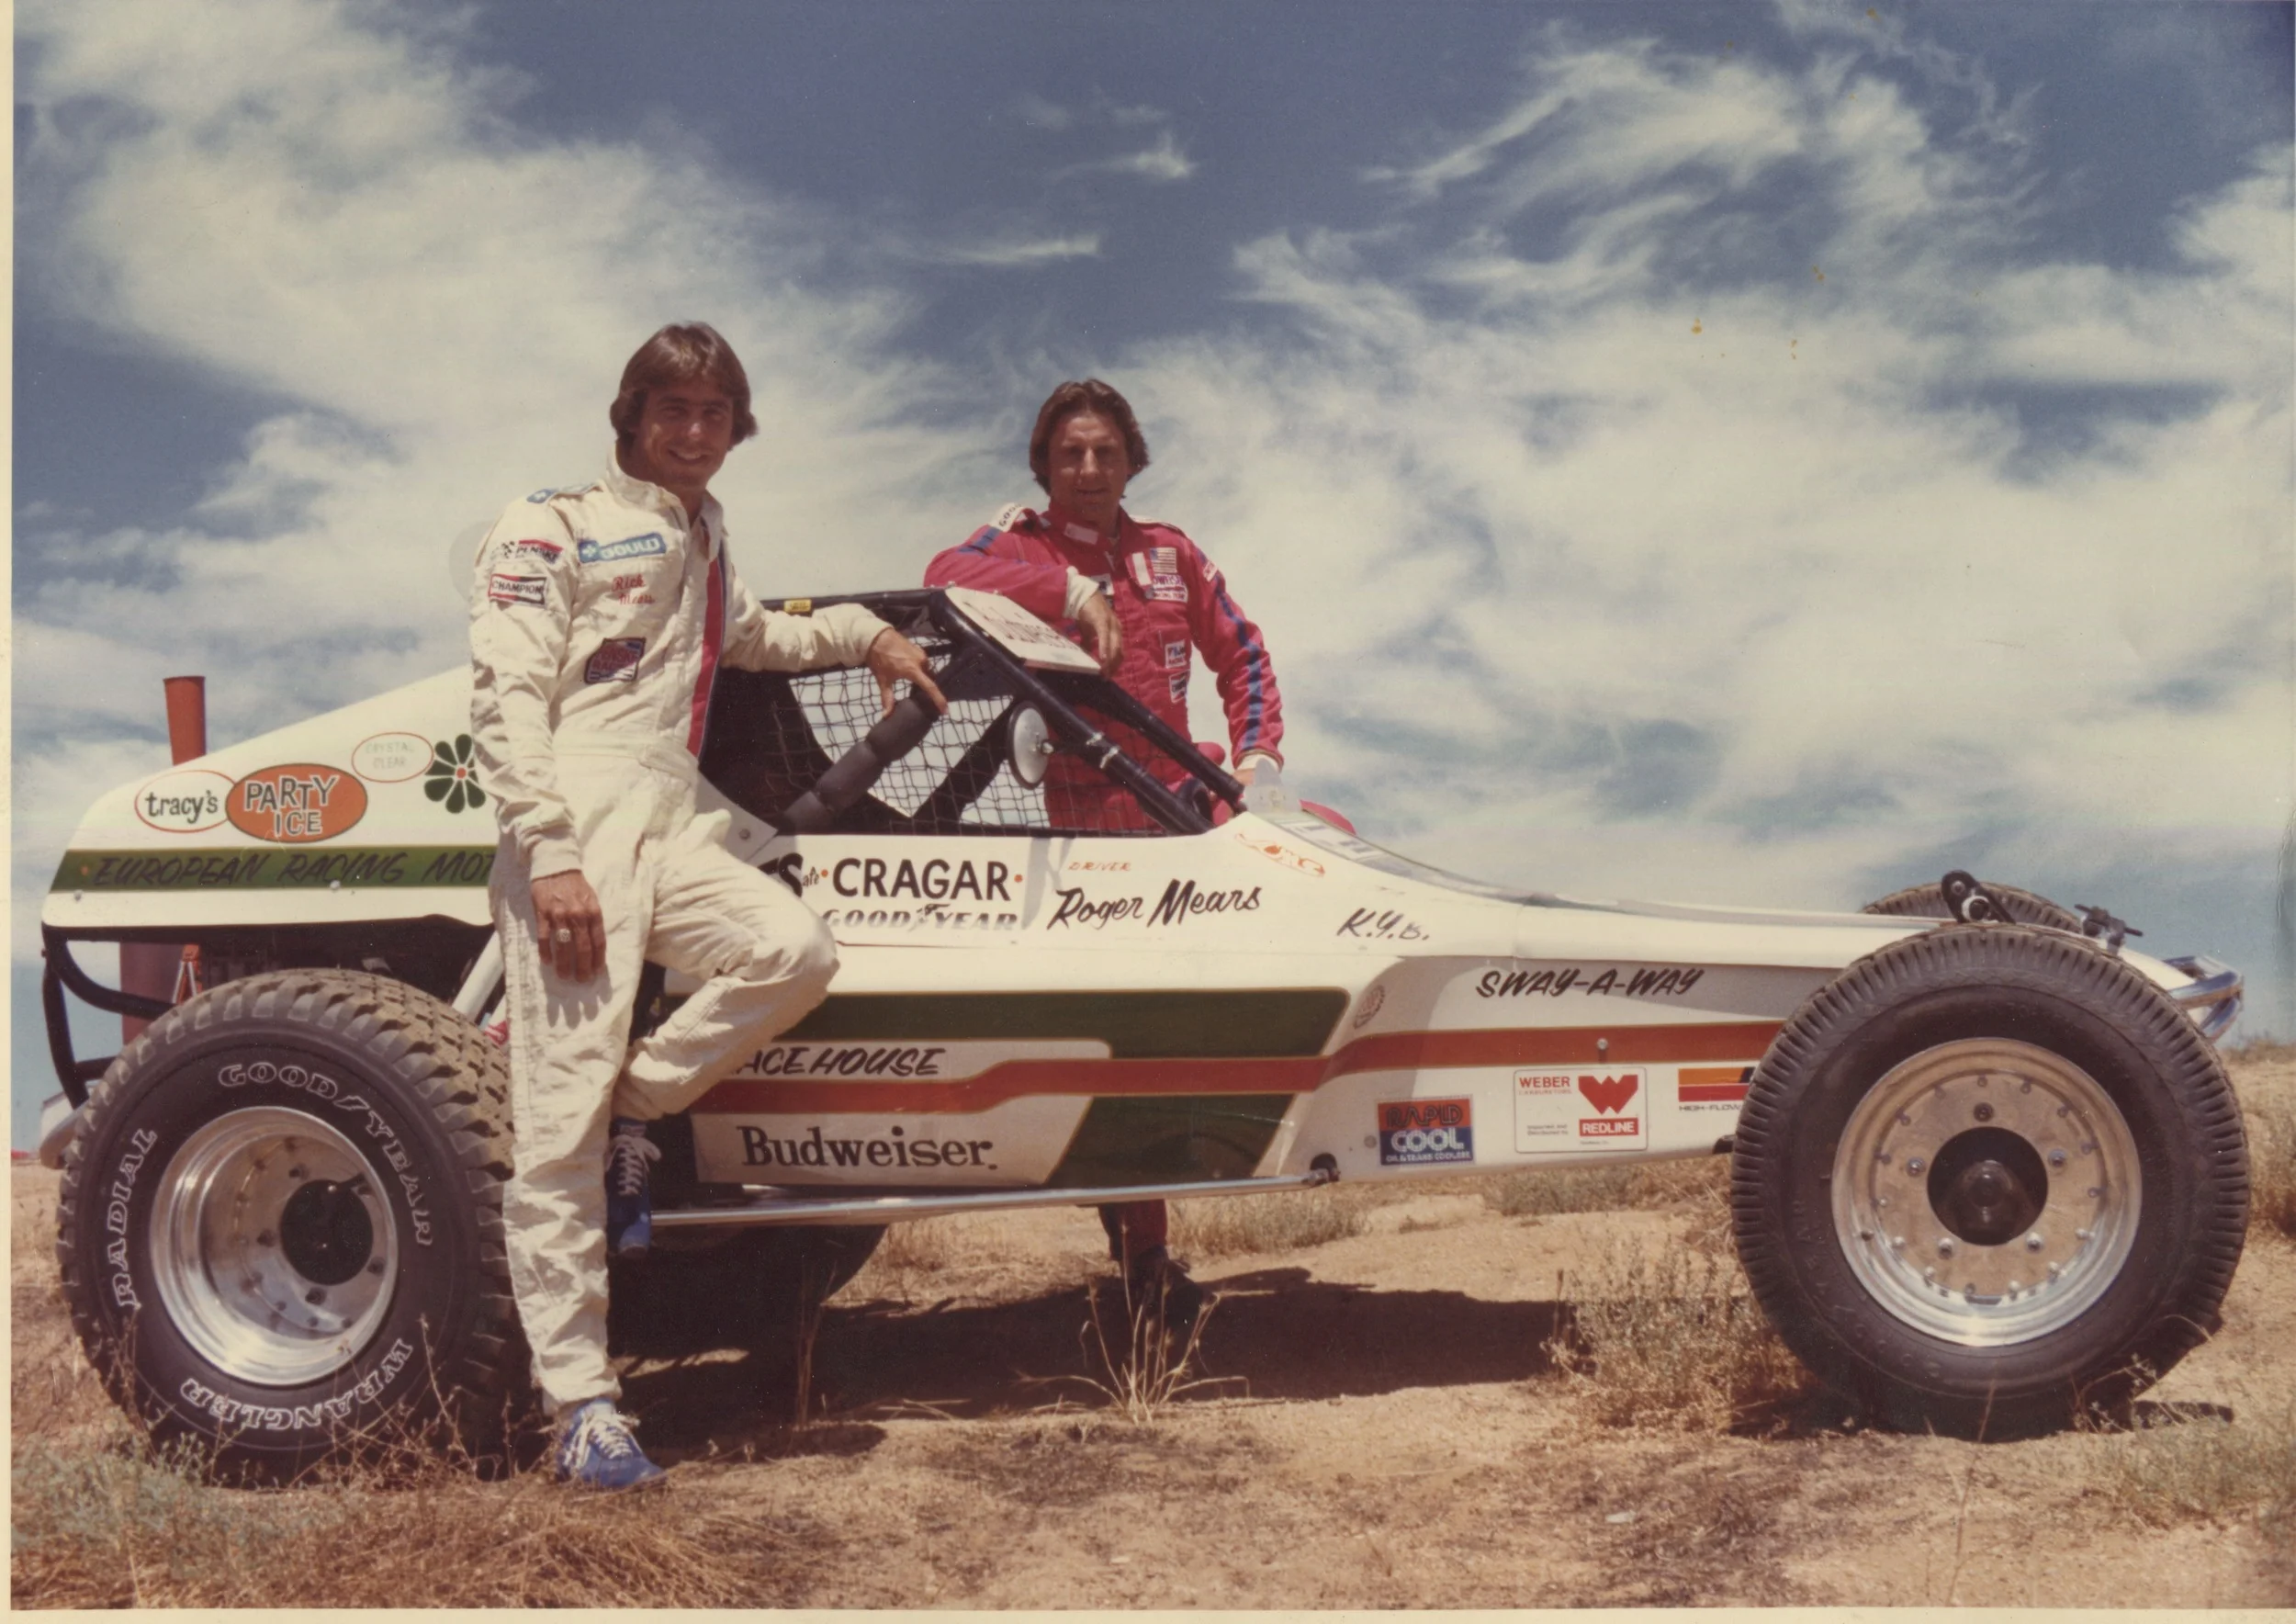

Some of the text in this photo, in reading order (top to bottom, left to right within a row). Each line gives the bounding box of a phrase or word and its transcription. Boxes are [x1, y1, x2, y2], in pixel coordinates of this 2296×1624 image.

[492, 579, 545, 595] CHAMPION
[145, 790, 219, 824] tracy's
[243, 774, 342, 814] PARTY
[273, 810, 322, 839] ICE
[94, 852, 272, 886] EUROPEAN
[276, 851, 410, 884] RACING
[832, 858, 1012, 901] CRAGAR
[1068, 861, 1132, 872] DRIVER
[1047, 878, 1262, 930] Roger Mears
[1476, 968, 1705, 998] SWAY-A-WAY
[809, 1048, 947, 1077] HOUSE
[1519, 1076, 1571, 1088] WEBER
[1387, 1104, 1463, 1128] RAPID
[1581, 1121, 1636, 1134] REDLINE
[1390, 1127, 1465, 1153] COOL
[107, 1126, 158, 1308] RADIAL
[179, 1337, 414, 1431] WRANGLER
